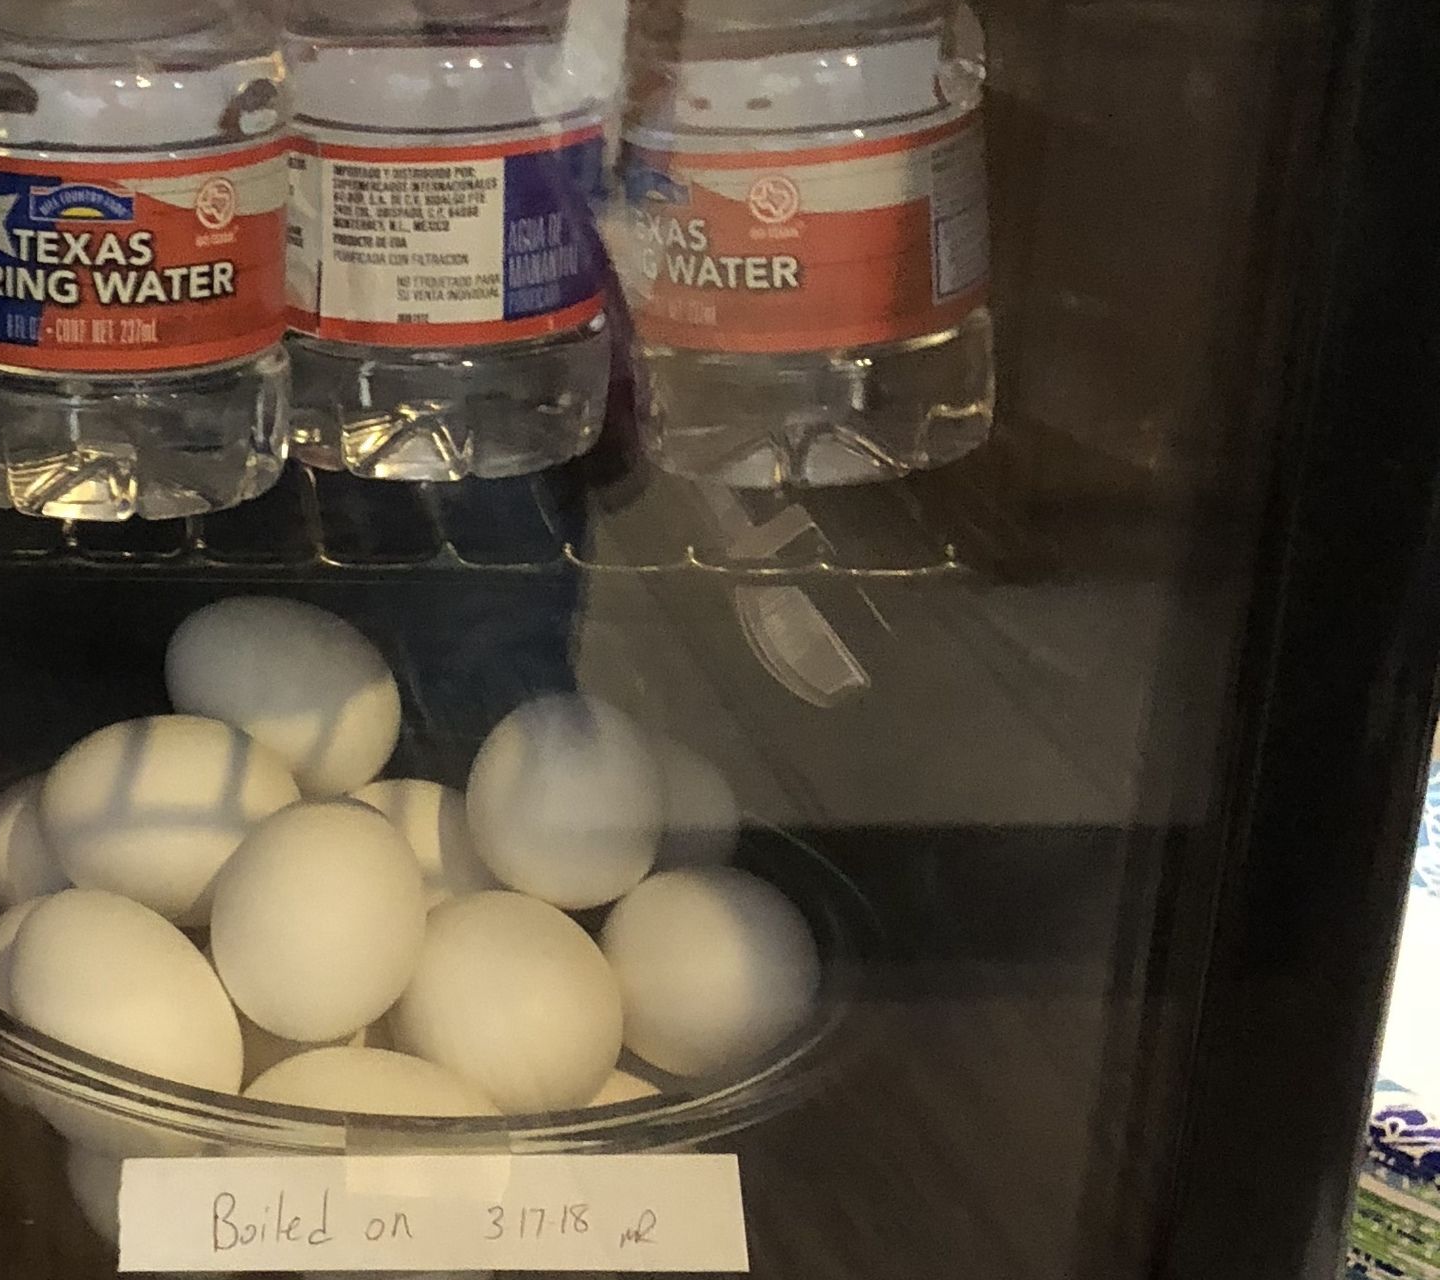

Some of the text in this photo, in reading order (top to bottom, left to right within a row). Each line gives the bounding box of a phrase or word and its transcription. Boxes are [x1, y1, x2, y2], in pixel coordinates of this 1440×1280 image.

[12, 229, 152, 266] TEXAS
[92, 262, 234, 304] WATER
[666, 255, 799, 289] WATER
[213, 1188, 332, 1252] Boiled
[365, 1212, 413, 1241] on
